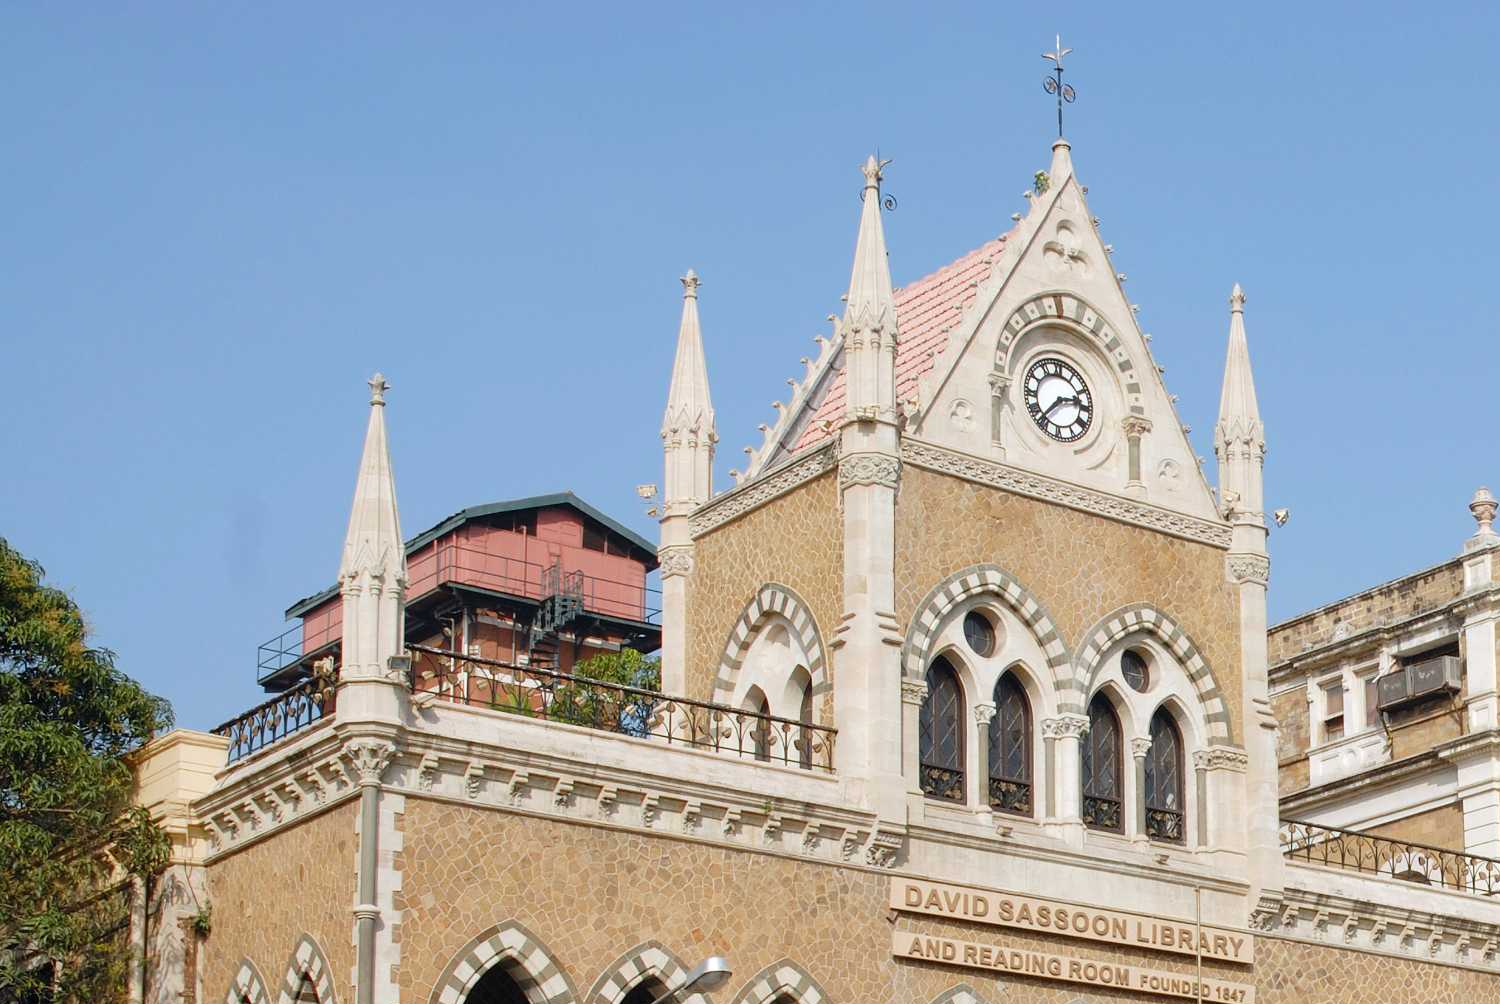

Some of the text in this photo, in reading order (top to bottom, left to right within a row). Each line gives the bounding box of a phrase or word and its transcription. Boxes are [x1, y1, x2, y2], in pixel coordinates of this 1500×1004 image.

[904, 884, 1244, 957] DAVID SASSOON LIBRARY
[908, 936, 1246, 1003] AND READING ROOM FOUNDED 1847
